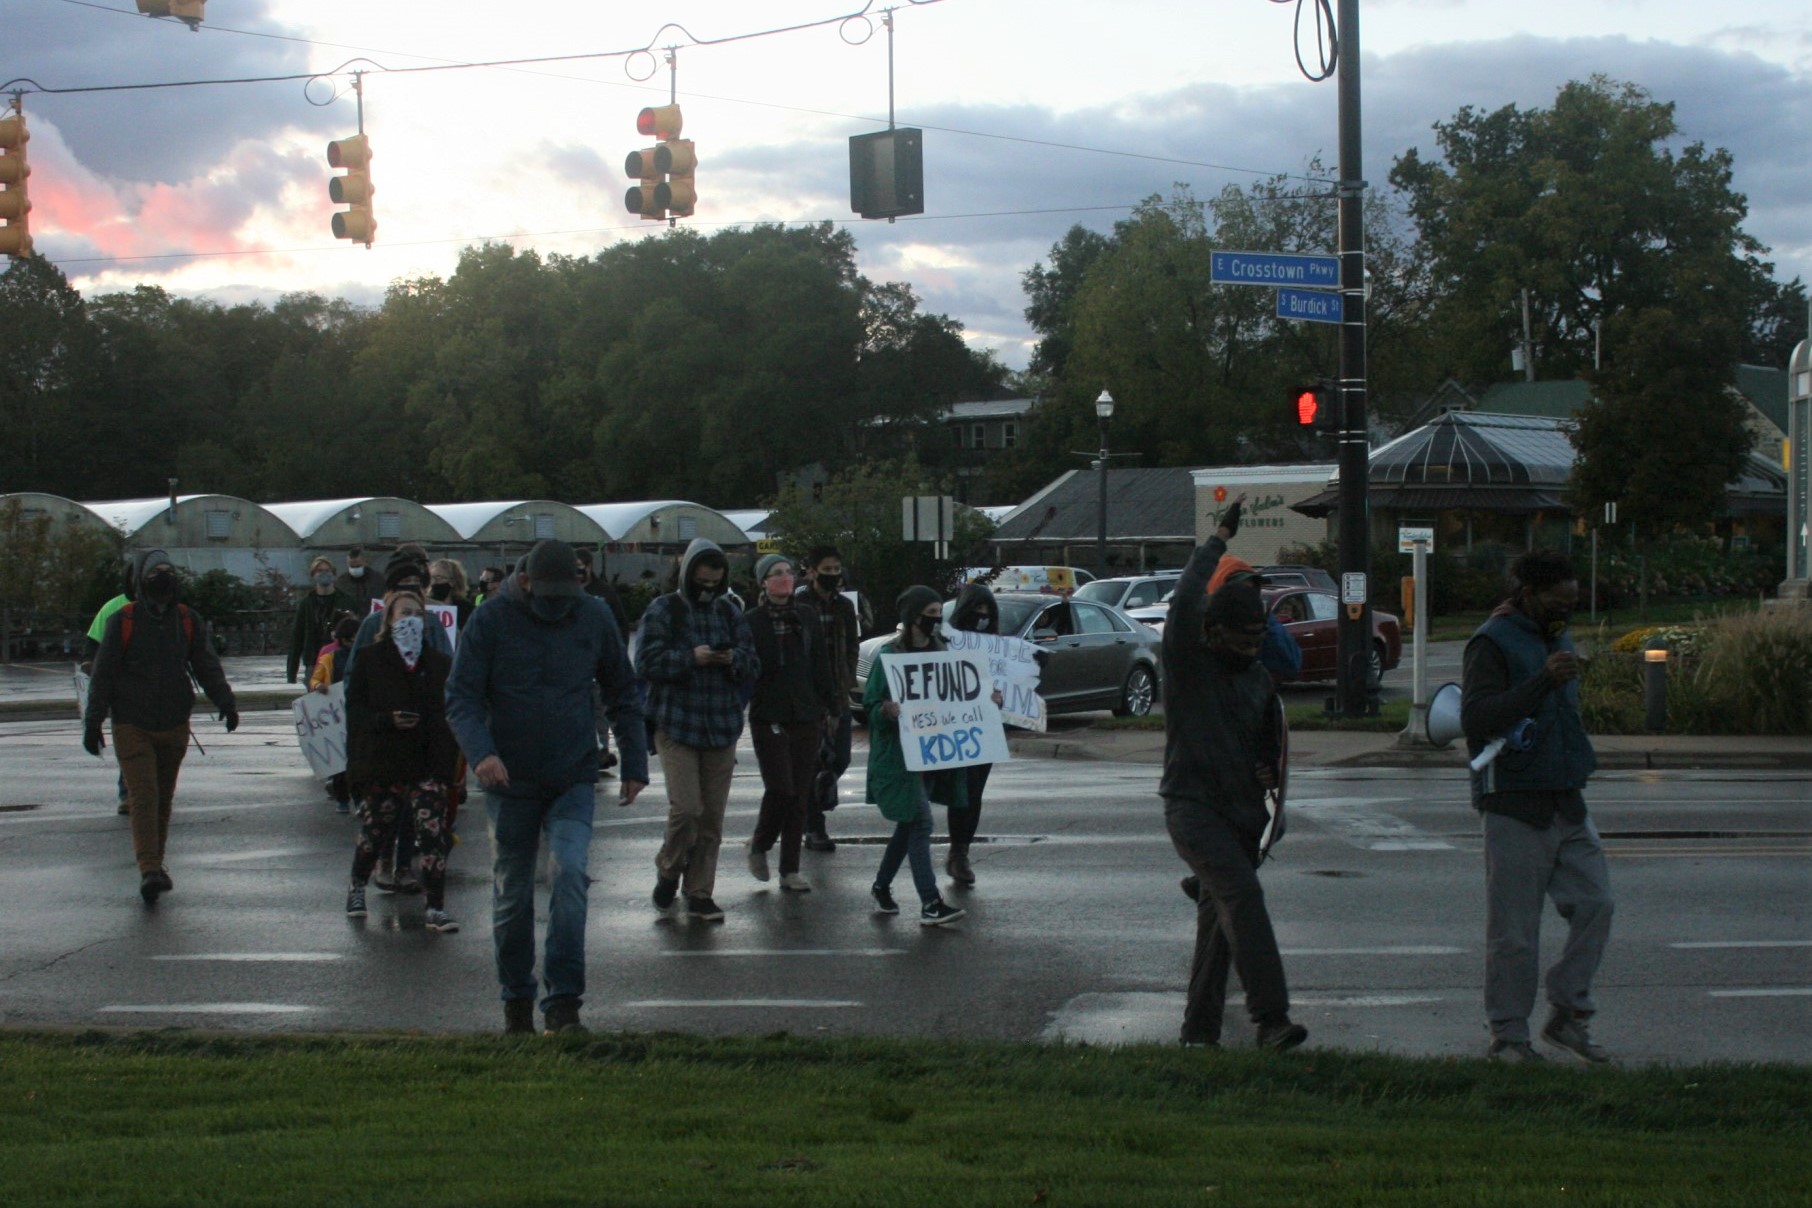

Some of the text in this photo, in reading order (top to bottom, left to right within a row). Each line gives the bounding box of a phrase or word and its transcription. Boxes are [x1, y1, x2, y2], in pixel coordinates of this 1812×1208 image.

[1217, 258, 1334, 279] E Crosstown Pkwy
[1281, 294, 1339, 316] S Burdick St
[891, 660, 981, 704] DEFUND
[912, 712, 938, 729] MESS
[962, 705, 984, 724] call
[918, 726, 984, 766] KDPS
